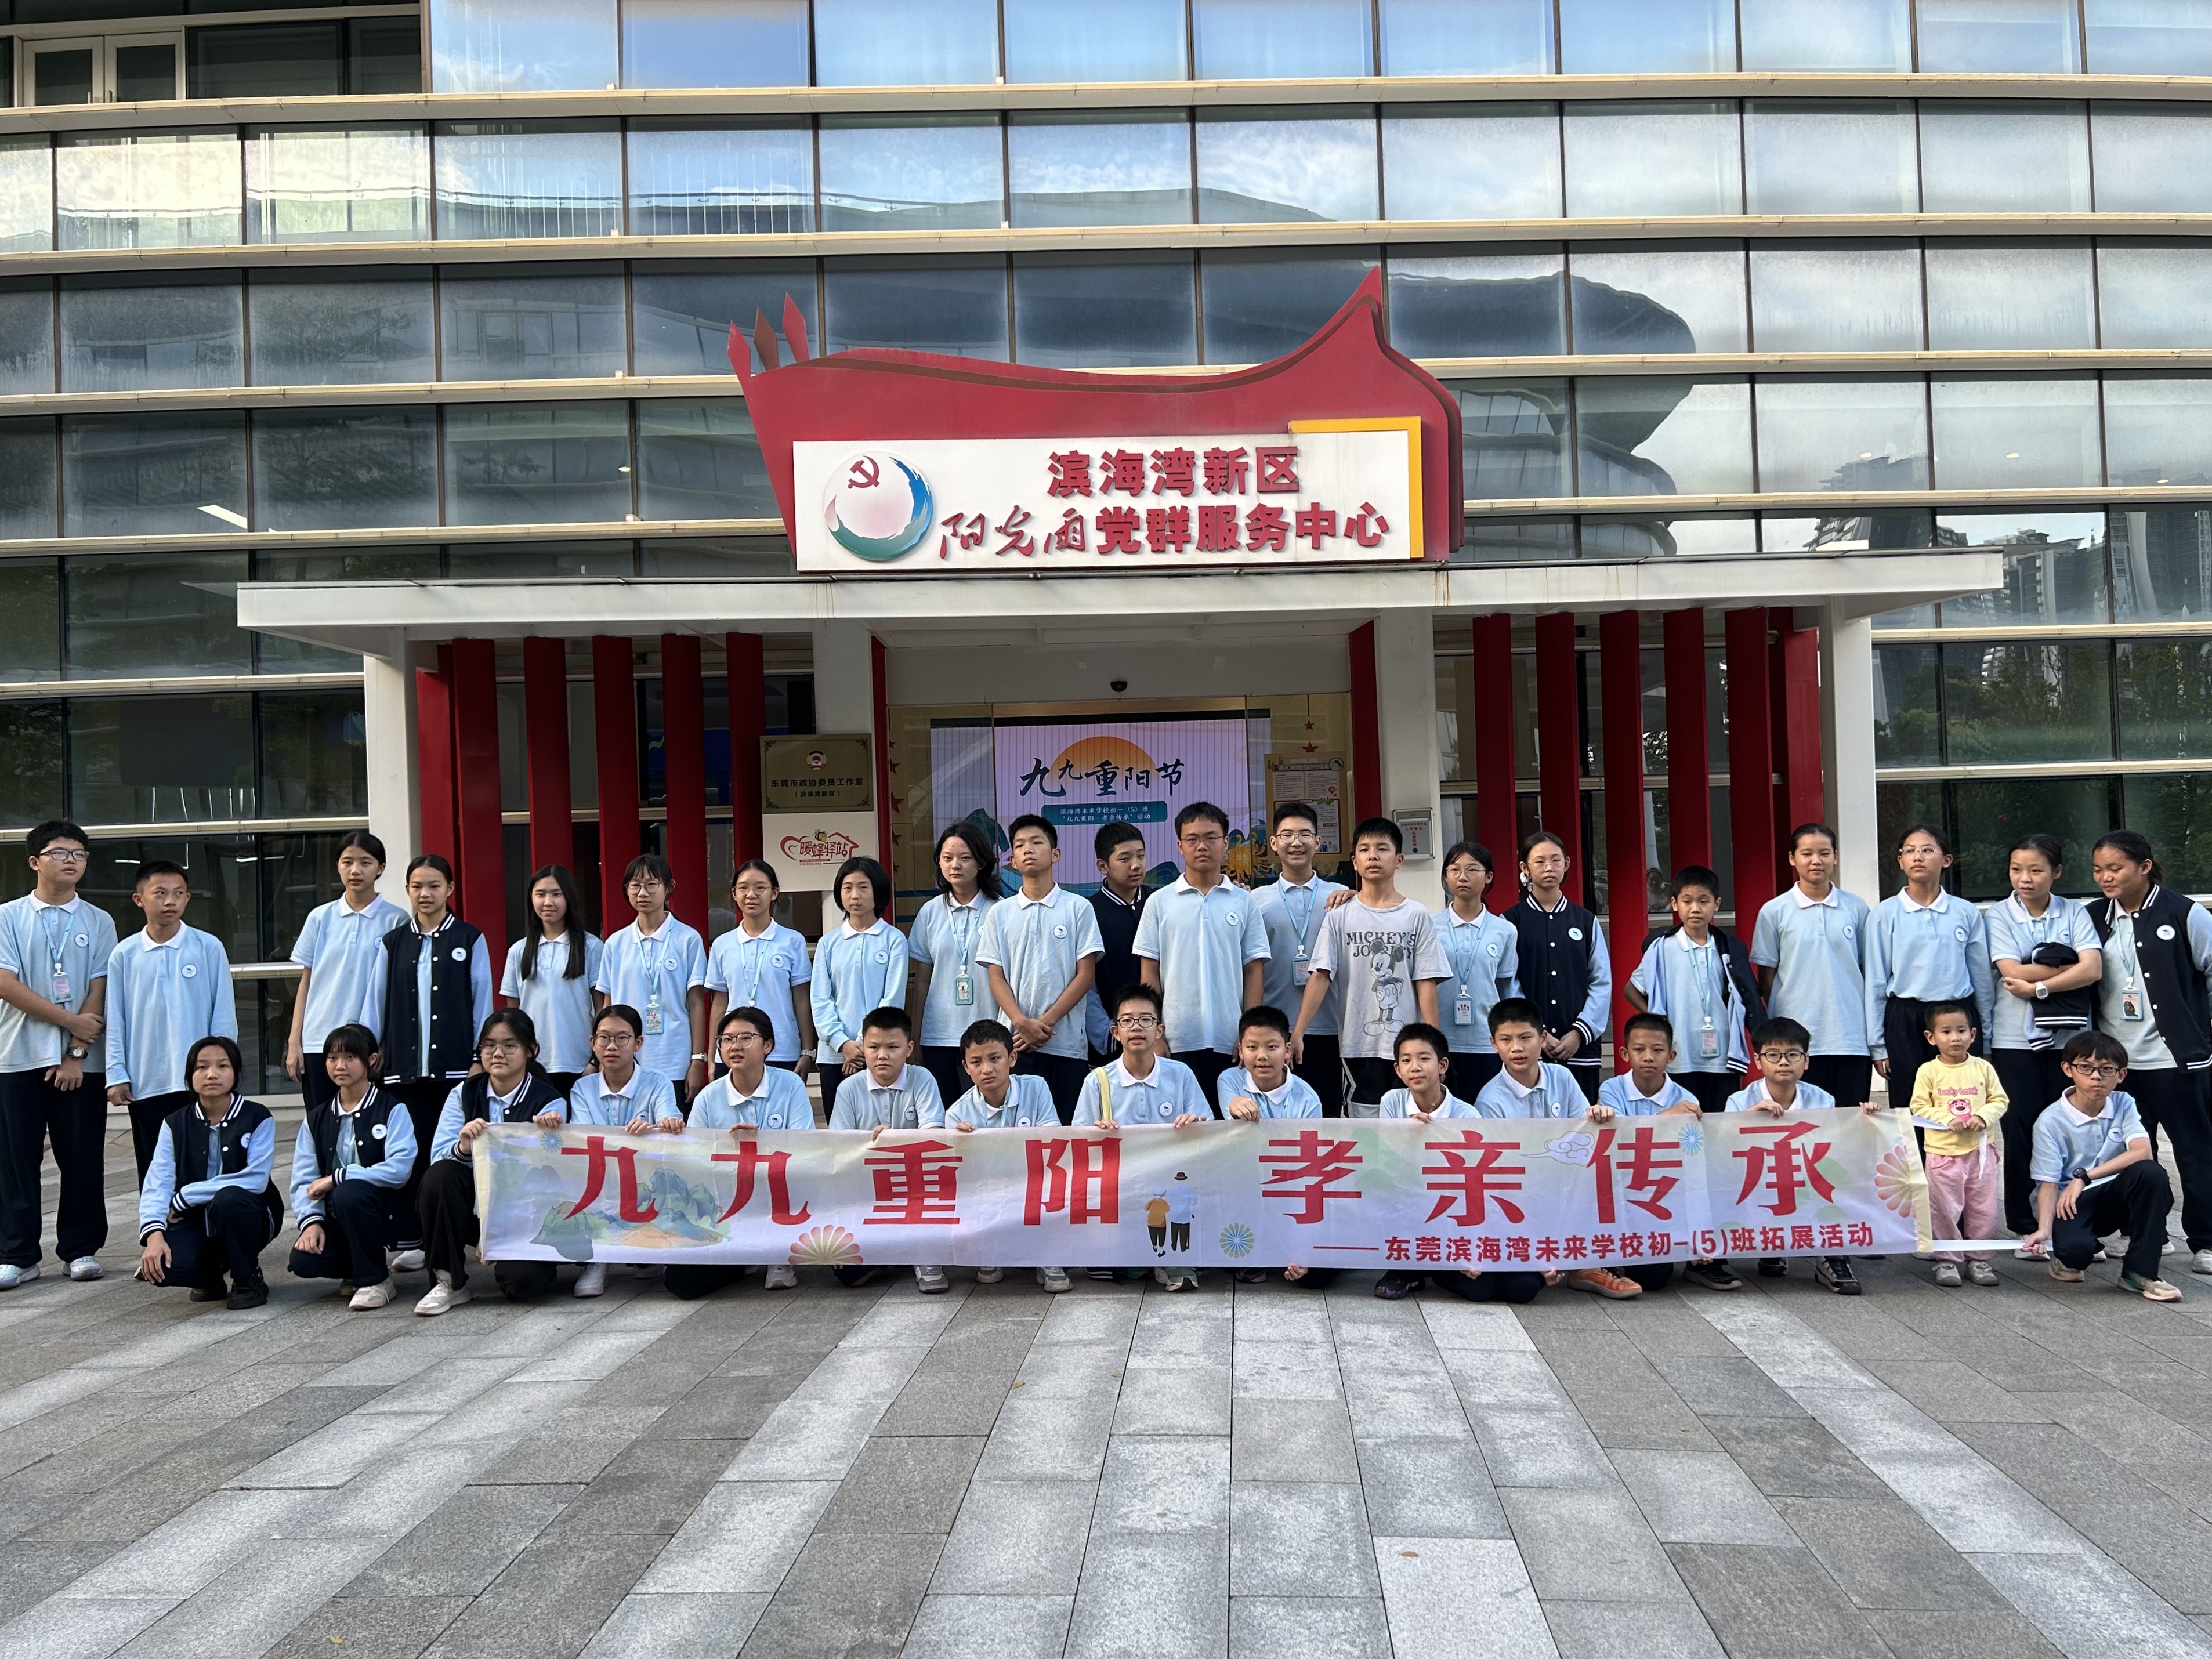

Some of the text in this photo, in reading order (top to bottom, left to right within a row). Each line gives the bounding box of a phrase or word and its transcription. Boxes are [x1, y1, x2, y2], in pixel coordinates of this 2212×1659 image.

[1047, 445, 1299, 497] 滨海湾新区
[771, 778, 863, 788] 东莞市政协委员工作室
[1019, 757, 1185, 797] 九九重阳节
[799, 841, 849, 859] 暖蜂驿站
[1345, 931, 1416, 947] MICKEY'S
[560, 1121, 1837, 1227] 九九重阳 孝亲传承
